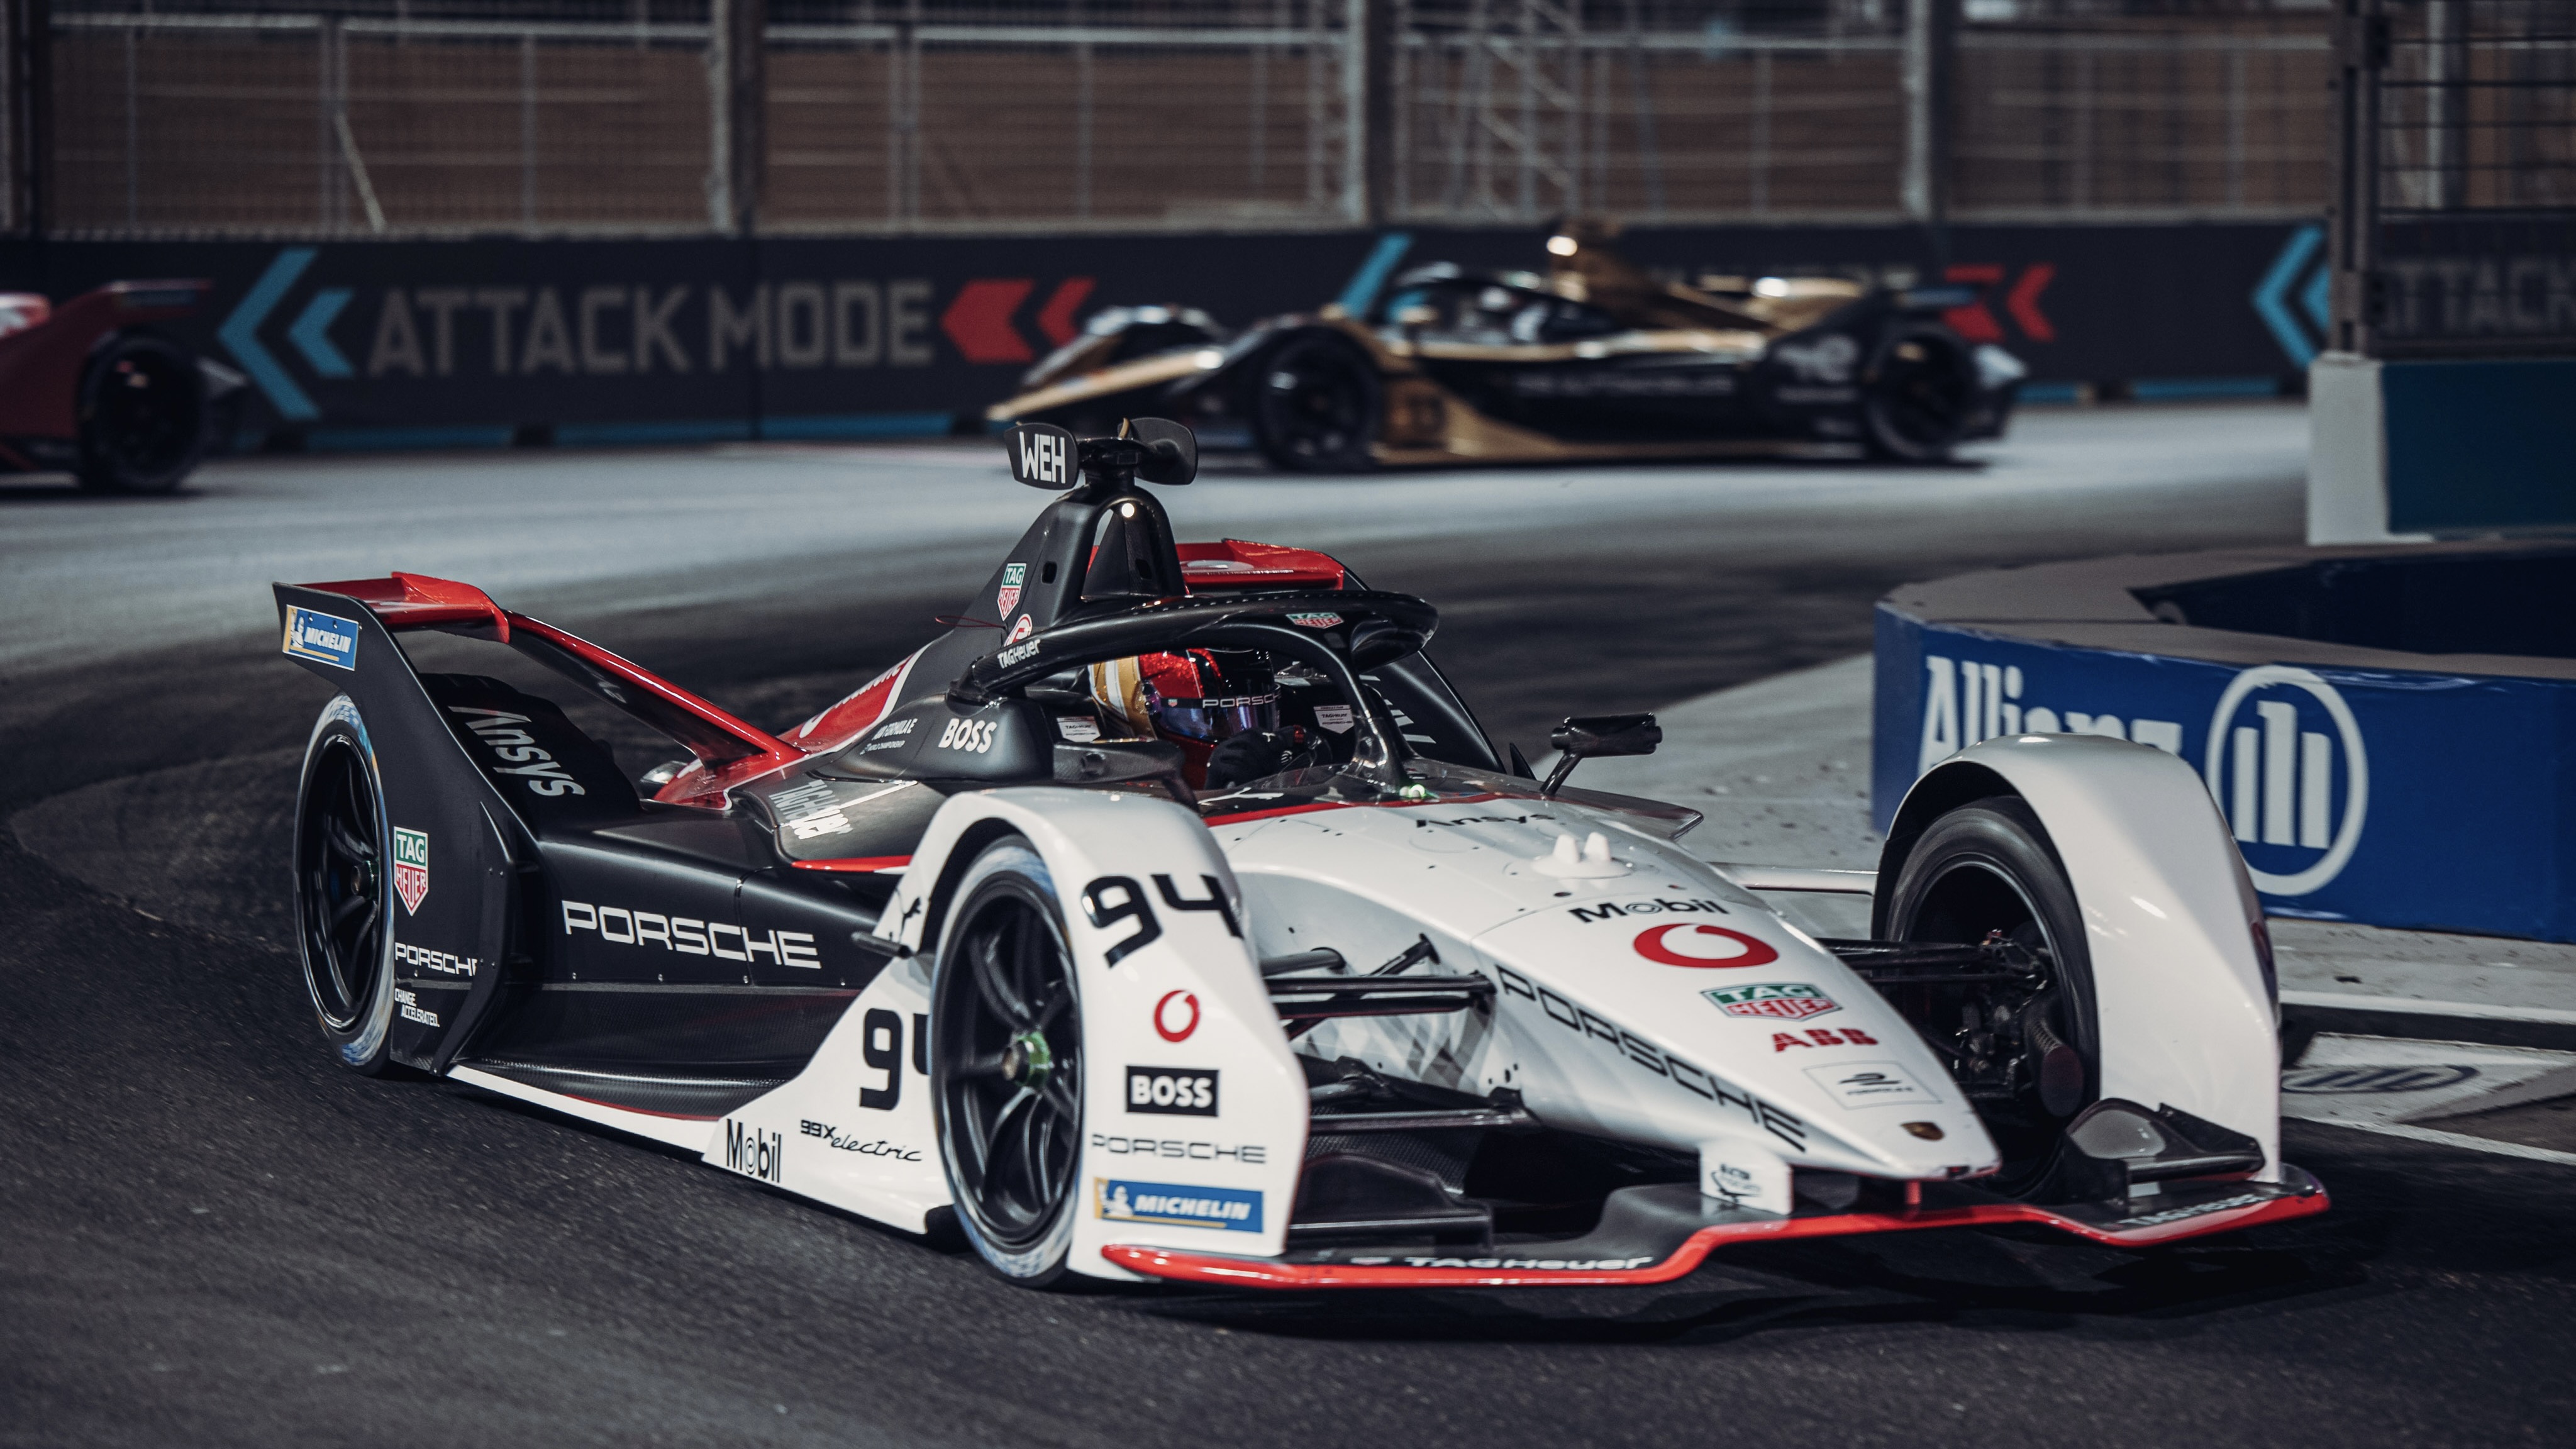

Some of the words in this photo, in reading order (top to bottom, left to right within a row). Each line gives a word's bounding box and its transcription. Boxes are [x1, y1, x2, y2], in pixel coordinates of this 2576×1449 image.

[369, 288, 691, 375] ATTACK
[709, 280, 934, 371] MODE
[1019, 431, 1066, 484] WEH
[1006, 566, 1023, 586] TAG
[999, 588, 1019, 618] HEUER
[304, 626, 352, 653] MICHELIN
[447, 706, 586, 796] Ansys
[938, 718, 997, 753] BOSS
[396, 833, 425, 863] TAG
[396, 865, 426, 908] HEUER
[1081, 874, 1246, 969] 94
[1568, 897, 1731, 923] Mobil
[561, 899, 822, 969] PORSCHE
[1715, 985, 1815, 1002] TAG
[1728, 998, 1831, 1019] HEUER
[1772, 1028, 1879, 1052] ABB
[1496, 965, 1806, 1153] PORSCHE
[1131, 1074, 1213, 1108] BOSS
[726, 1118, 782, 1183] Mobil
[1092, 1133, 1267, 1164] PORSCHE
[1135, 1194, 1252, 1220] MICHELIN
